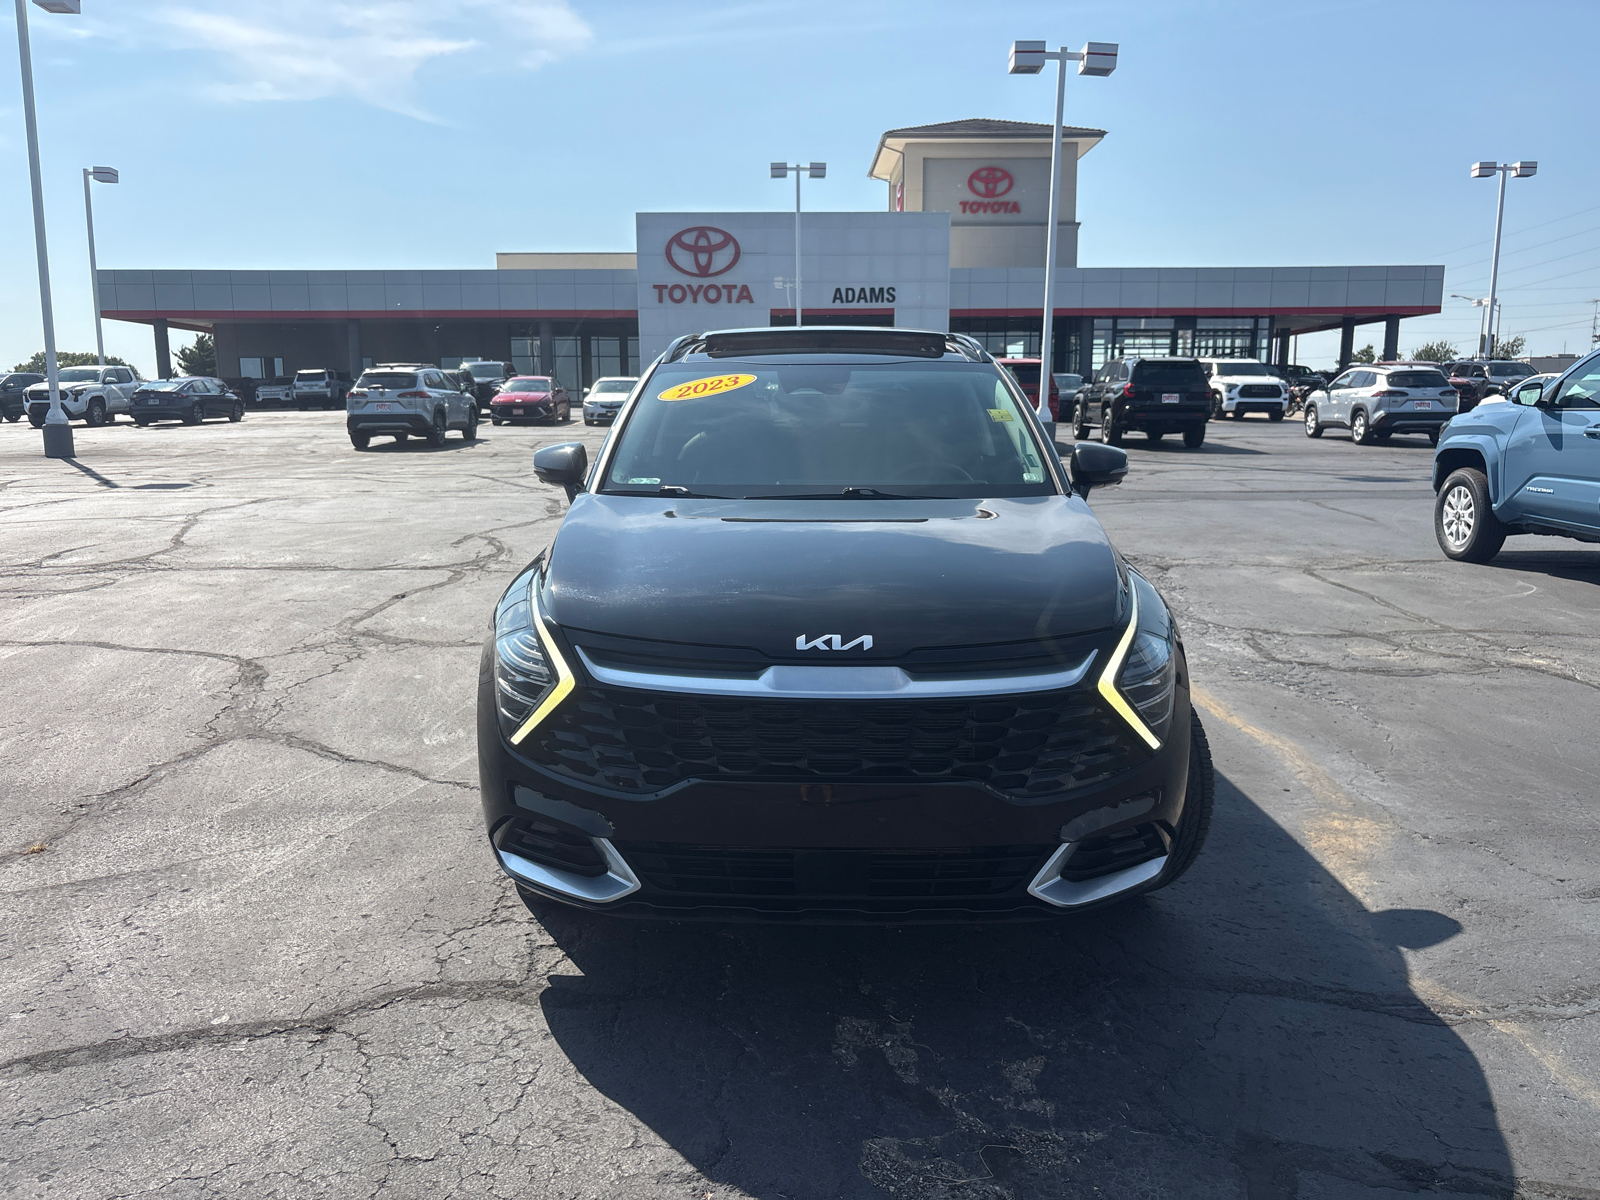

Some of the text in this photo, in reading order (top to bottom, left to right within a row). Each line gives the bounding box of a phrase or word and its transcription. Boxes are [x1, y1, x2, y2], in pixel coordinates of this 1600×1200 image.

[959, 201, 1021, 214] TOYOTA
[652, 284, 754, 304] TOYOTA
[832, 287, 896, 304] ADAMS
[677, 376, 740, 399] 2023
[796, 634, 873, 651] KIA
